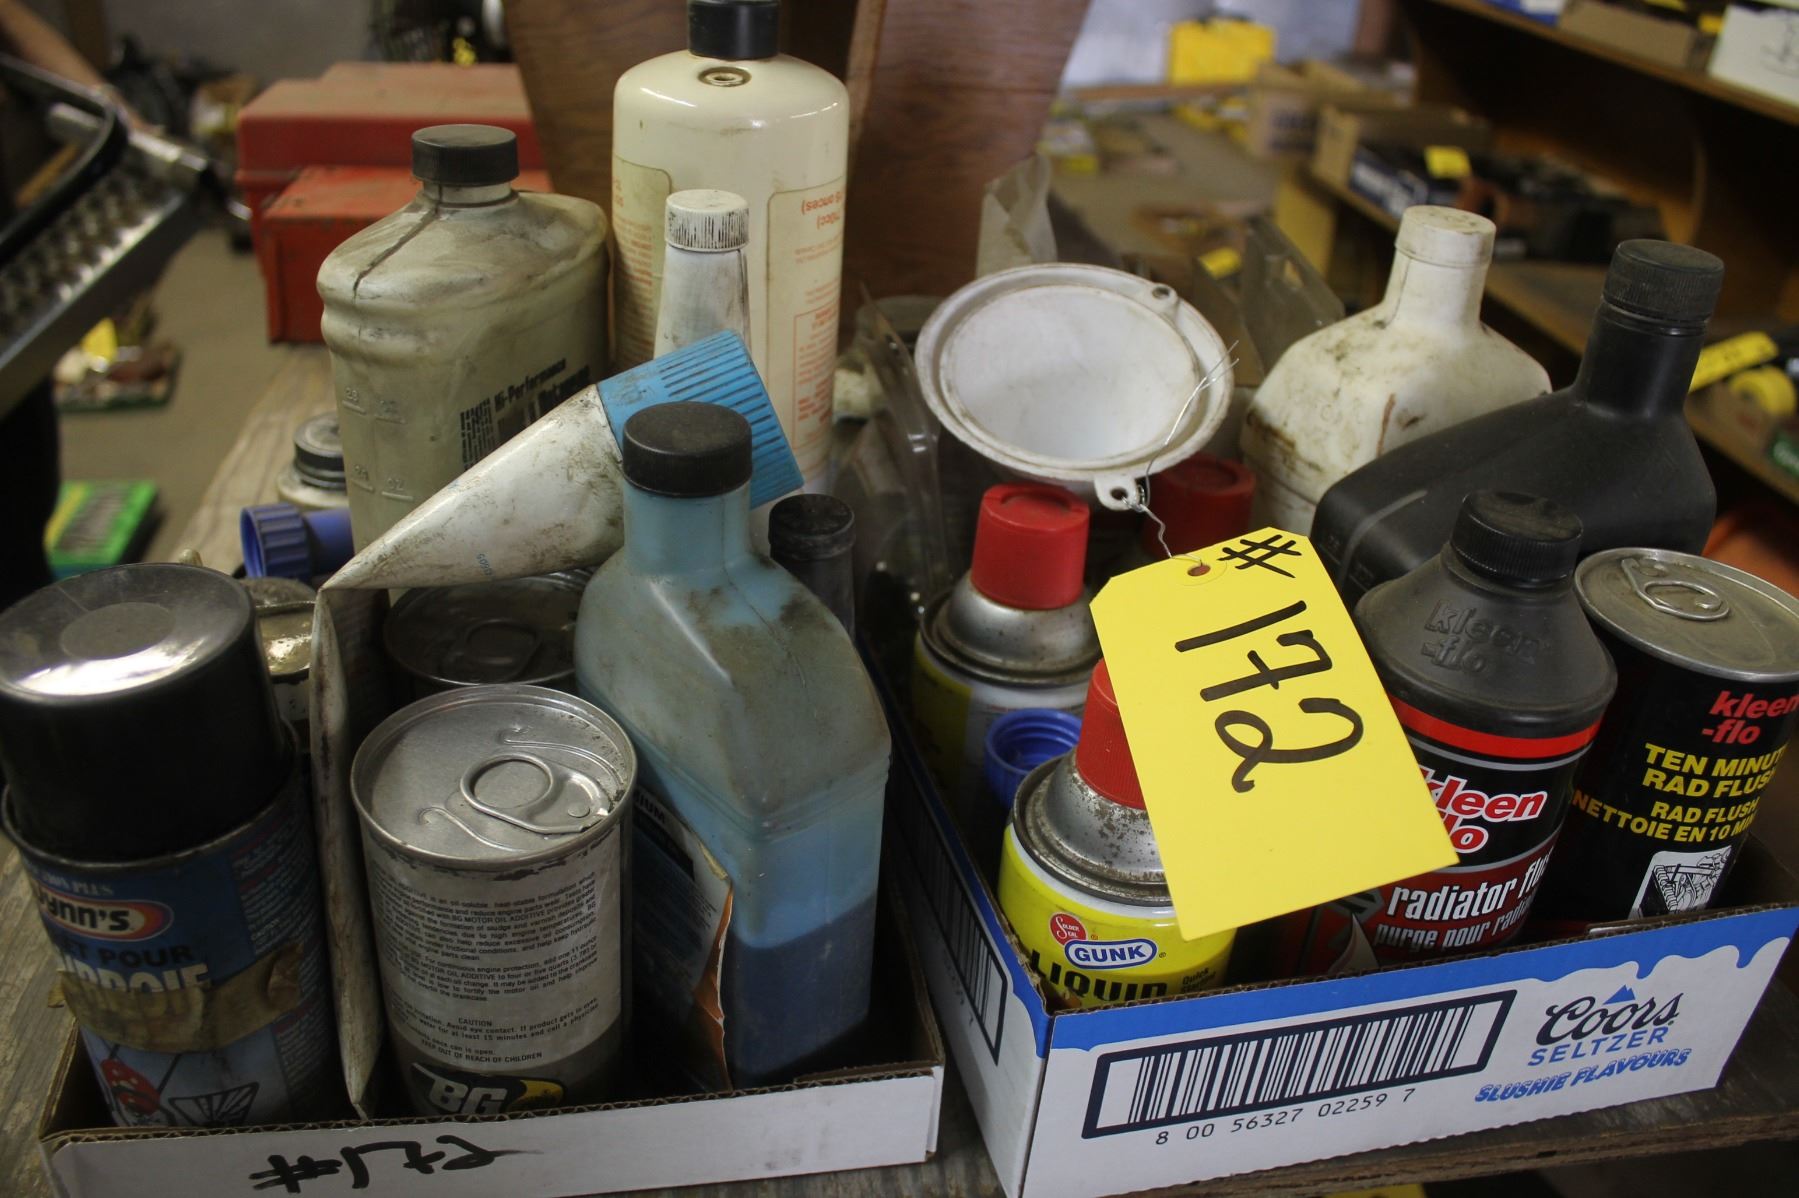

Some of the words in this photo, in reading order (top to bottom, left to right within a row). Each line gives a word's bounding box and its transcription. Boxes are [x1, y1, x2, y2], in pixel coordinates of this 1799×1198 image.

[1702, 718, 1761, 746] -flo
[1645, 742, 1709, 775] TEN
[1642, 767, 1710, 797] RAD
[1572, 787, 1673, 840] NETTOIE
[1673, 824, 1708, 843] EN
[1709, 823, 1732, 842] 10
[1650, 800, 1702, 824] RAD
[1386, 877, 1518, 921] radiator
[451, 914, 462, 923] BG
[463, 916, 493, 925] MOTOR
[494, 915, 507, 924] OIL
[510, 908, 545, 923] ADDITIVE
[513, 921, 528, 930] and
[475, 939, 501, 948] reduce
[490, 931, 508, 941] high
[1373, 922, 1440, 953] purge
[1442, 921, 1491, 949] pour
[98, 945, 194, 968] POUR
[521, 944, 536, 952] and
[1074, 945, 1147, 962] GUNK
[476, 966, 501, 974] engine
[543, 956, 557, 966] add
[557, 951, 571, 962] one
[460, 972, 497, 980] ADDITIVE
[500, 979, 517, 989] may
[517, 978, 528, 986] be
[541, 980, 556, 989] and
[451, 1029, 460, 1038] at
[461, 1032, 482, 1042] least
[483, 1034, 494, 1042] 15
[495, 1032, 528, 1042] minutes
[530, 1029, 546, 1038] and
[546, 1022, 562, 1034] call
[568, 1003, 600, 1025] physician
[458, 1016, 494, 1028] CAUTION
[529, 1017, 558, 1031] product
[558, 1011, 575, 1024] gets
[1536, 993, 1684, 1046] Coors
[437, 1046, 453, 1057] OUT
[453, 1051, 464, 1060] OF
[463, 1053, 491, 1063] REACH
[492, 1055, 503, 1064] OF
[503, 1050, 544, 1064] CHILDREN
[1527, 1026, 1669, 1067] SELTZER
[1474, 1071, 1571, 1103] SLUSHIE
[1569, 1048, 1692, 1088] FLAVOURS
[411, 1062, 508, 1115] BG
[1155, 1130, 1169, 1146] 8
[1186, 1124, 1215, 1141] 00
[1231, 1108, 1304, 1134] 56327
[1317, 1093, 1388, 1119] 02259
[1402, 1088, 1415, 1104] 7
